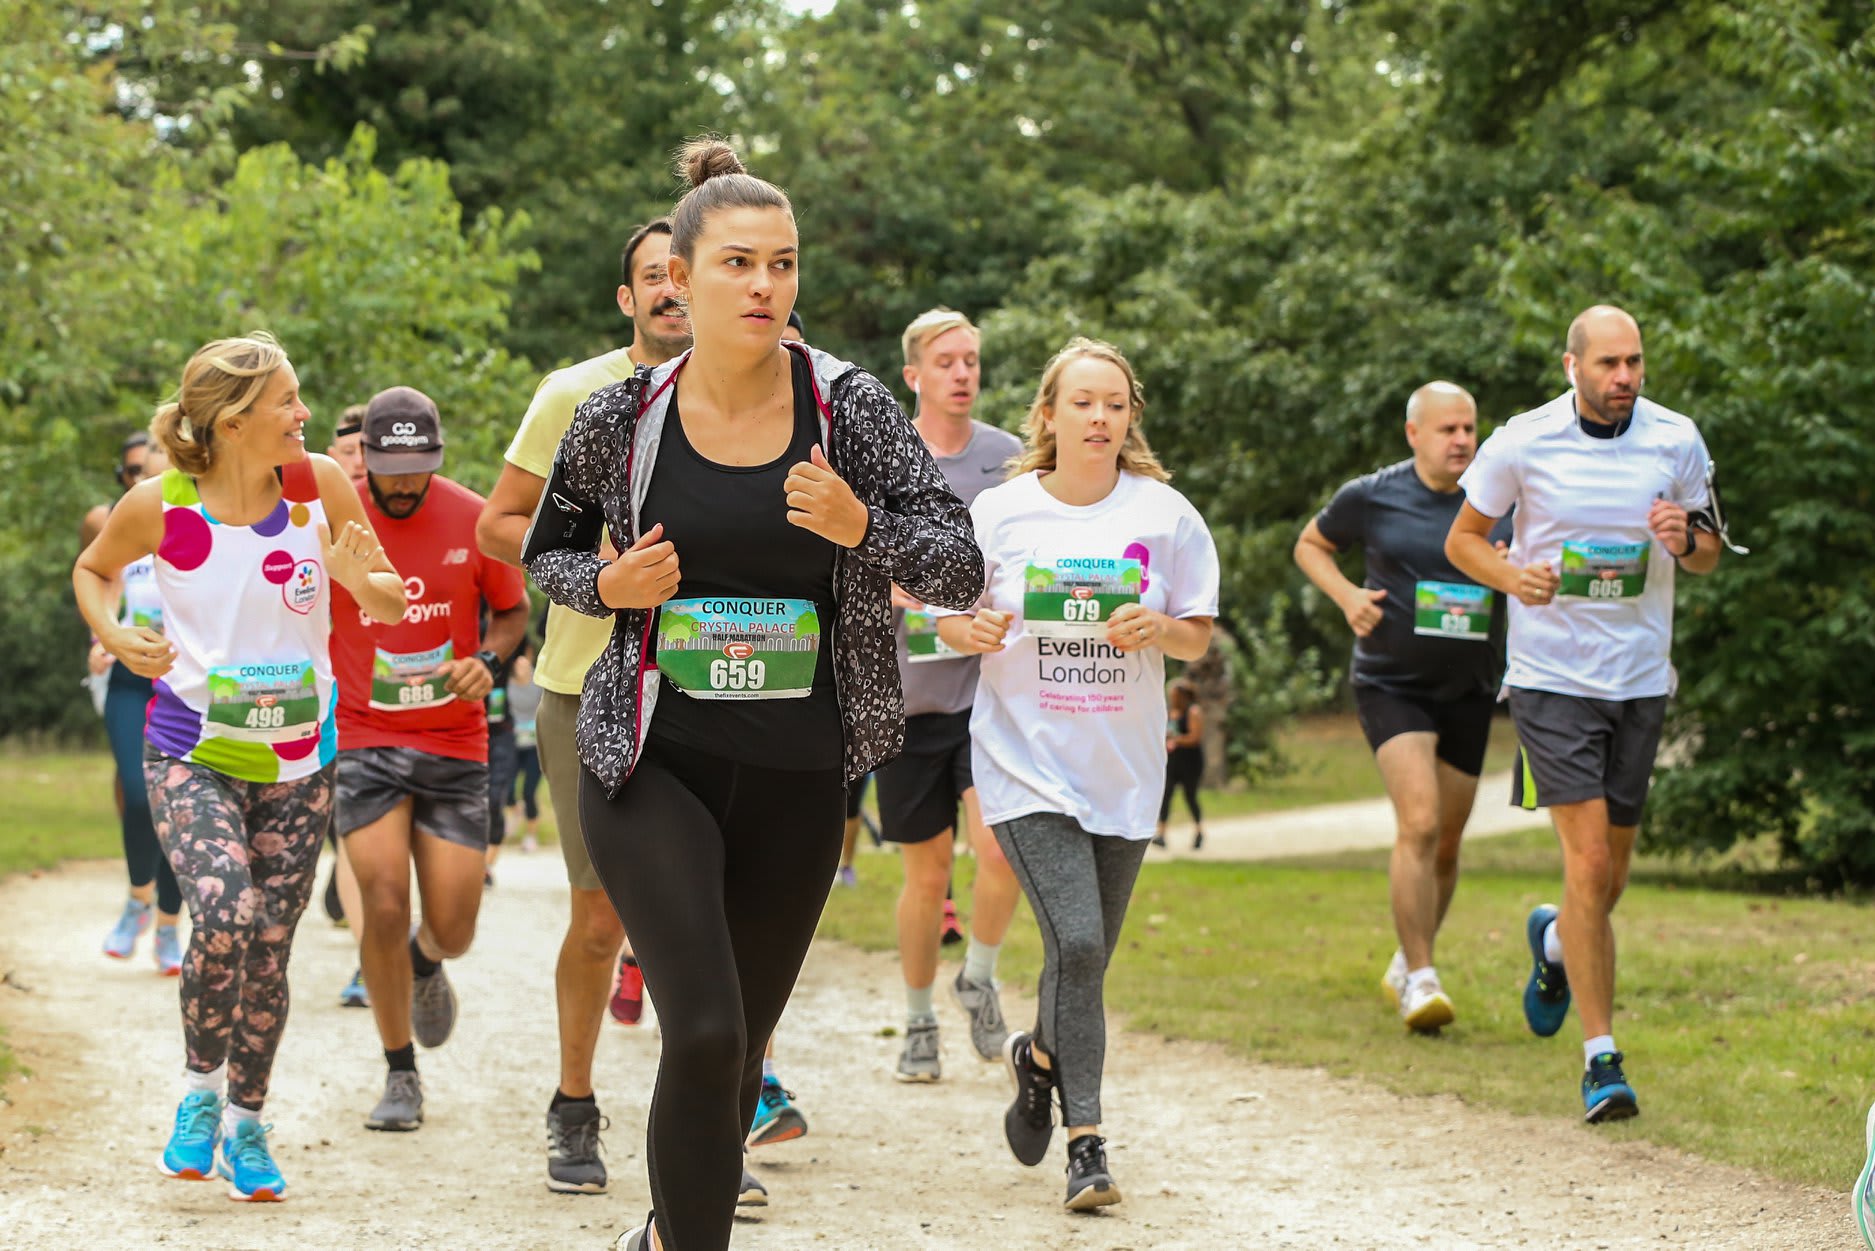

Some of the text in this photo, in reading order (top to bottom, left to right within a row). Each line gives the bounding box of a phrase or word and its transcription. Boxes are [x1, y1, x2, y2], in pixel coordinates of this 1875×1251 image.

[380, 435, 429, 447] goodgym
[1056, 559, 1115, 569] CONQUER
[1588, 579, 1624, 597] 605
[359, 602, 451, 627] ggym
[702, 601, 786, 616] CONQUER
[1063, 598, 1100, 621] 679
[691, 621, 796, 634] CRYSTAL PALACE
[712, 633, 766, 642] HALF MARATHON
[392, 650, 441, 664] CONQUER
[240, 664, 299, 677] CONQUER
[710, 659, 766, 690] 659
[1038, 659, 1125, 684] London
[1040, 690, 1086, 703] Celebrating
[1050, 704, 1076, 713] caring
[245, 706, 285, 728] 498
